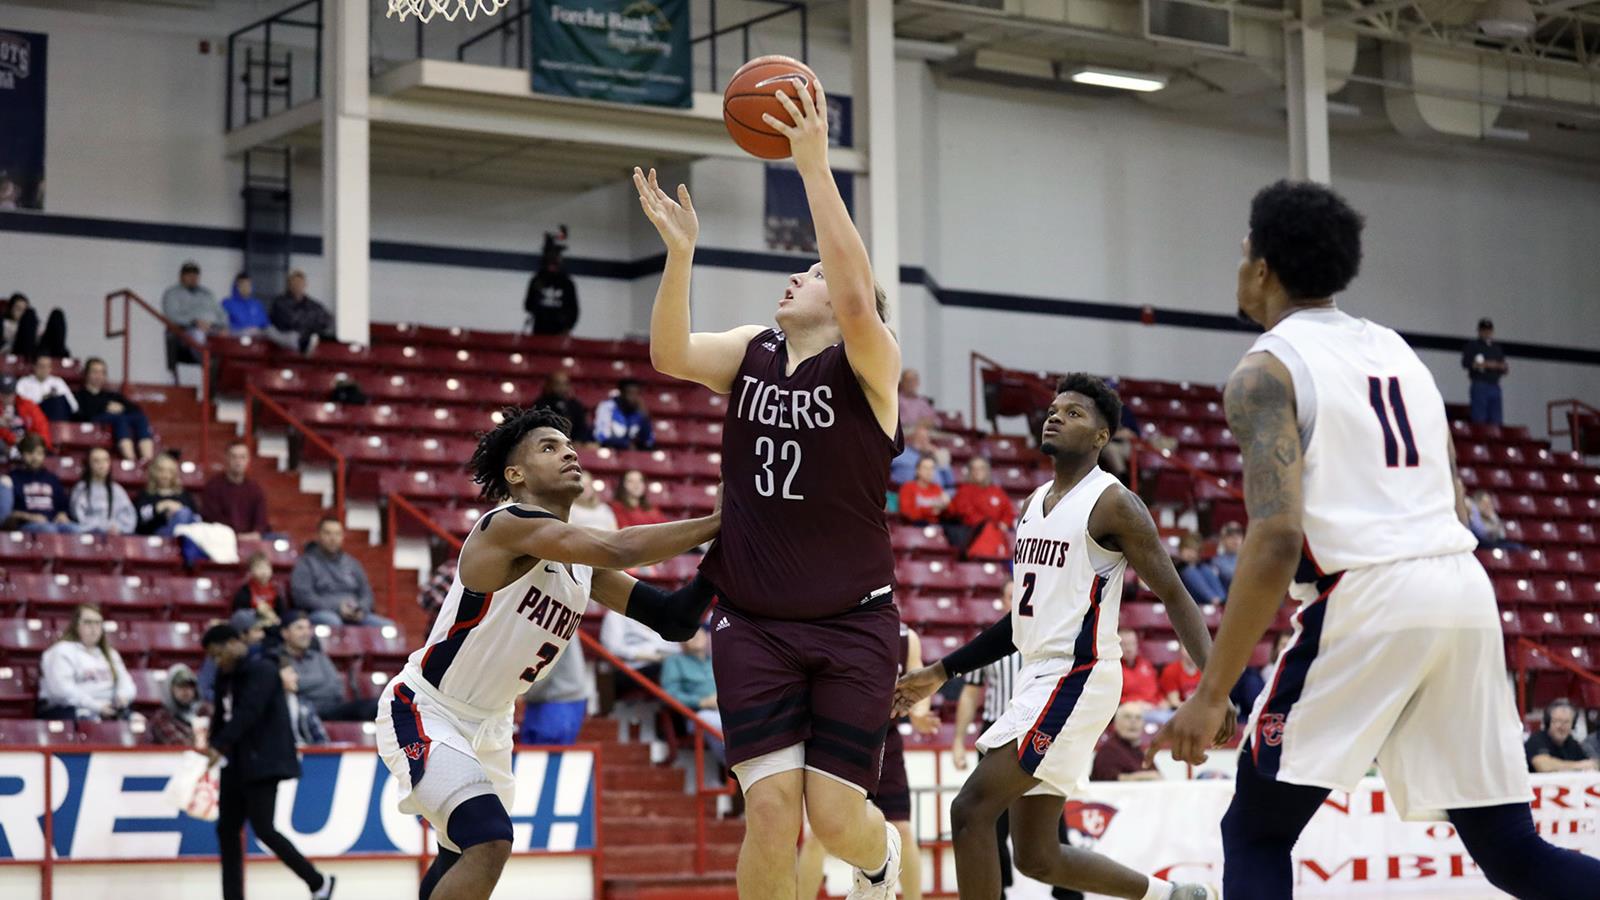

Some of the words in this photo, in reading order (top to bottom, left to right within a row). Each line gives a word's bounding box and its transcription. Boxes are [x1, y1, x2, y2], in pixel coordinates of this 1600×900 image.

[608, 12, 652, 33] Bank
[737, 375, 835, 430] TIGERS
[1367, 375, 1419, 468] 11
[755, 436, 804, 500] 32
[1014, 538, 1069, 568] PATRIOTS
[516, 585, 584, 641] PATRIO
[1018, 572, 1036, 617] 2
[519, 641, 559, 683] 3
